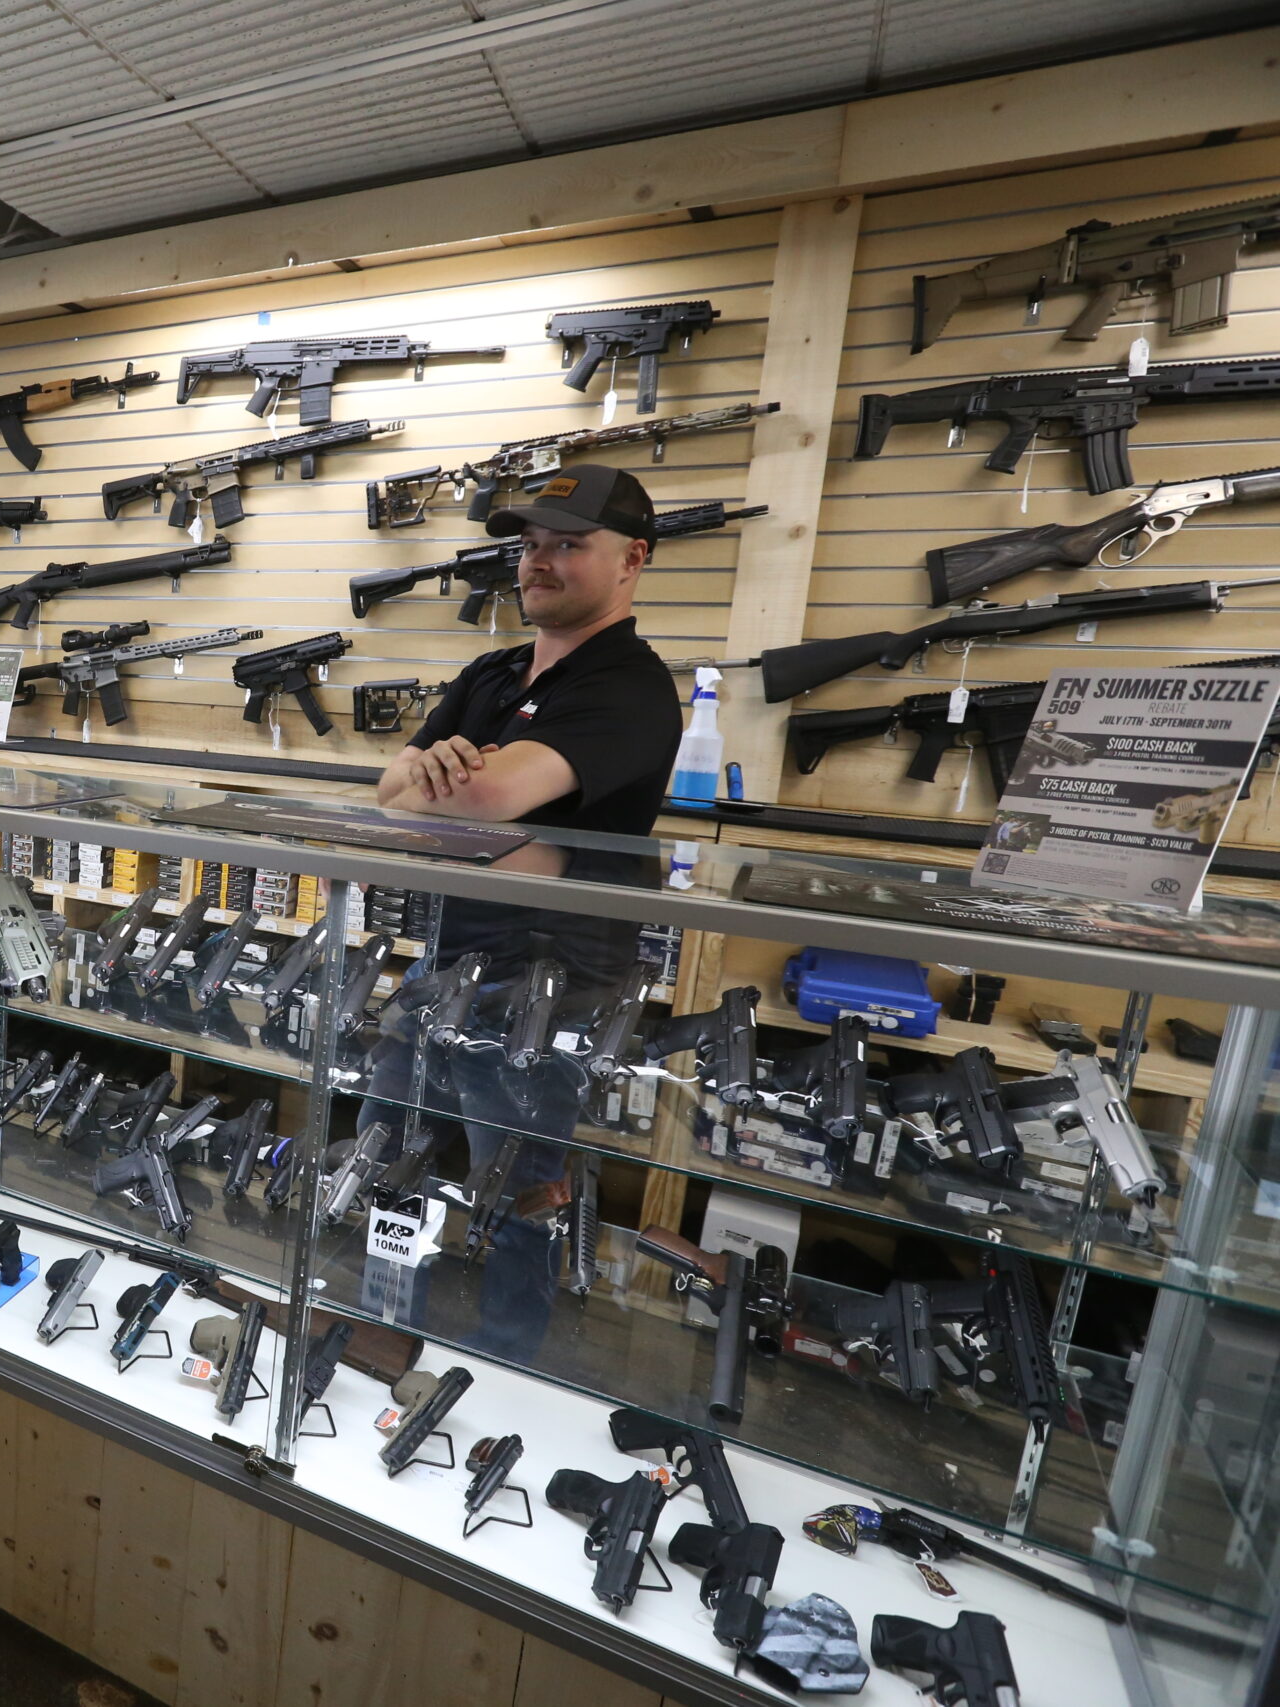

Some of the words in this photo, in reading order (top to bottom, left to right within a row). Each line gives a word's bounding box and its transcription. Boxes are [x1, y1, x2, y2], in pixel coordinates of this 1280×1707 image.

[1053, 678, 1091, 699] FN
[1093, 678, 1187, 700] SUMMER
[1189, 679, 1269, 702] SIZZLE
[1047, 700, 1081, 715] 509
[1148, 702, 1188, 715] REBATE
[1099, 715, 1122, 726] JULY
[1122, 716, 1144, 727] 17TH
[1149, 717, 1205, 729] SEPTEMBER
[1205, 719, 1232, 730] 30TH
[1106, 737, 1133, 750] $100
[1133, 739, 1165, 752] CASH
[1165, 740, 1197, 754] BACK
[1040, 777, 1060, 790] $75
[1060, 780, 1088, 793] CASH
[1088, 782, 1118, 795] BACK
[1049, 826, 1055, 835] 3
[1055, 827, 1078, 837] HOURS
[1088, 831, 1111, 841] PISTOL
[1112, 834, 1147, 845] TRAINING
[1150, 837, 1168, 848] $120
[1170, 840, 1195, 851] VALUE
[374, 1219, 415, 1240] M&P
[374, 1238, 410, 1256] 10MM
